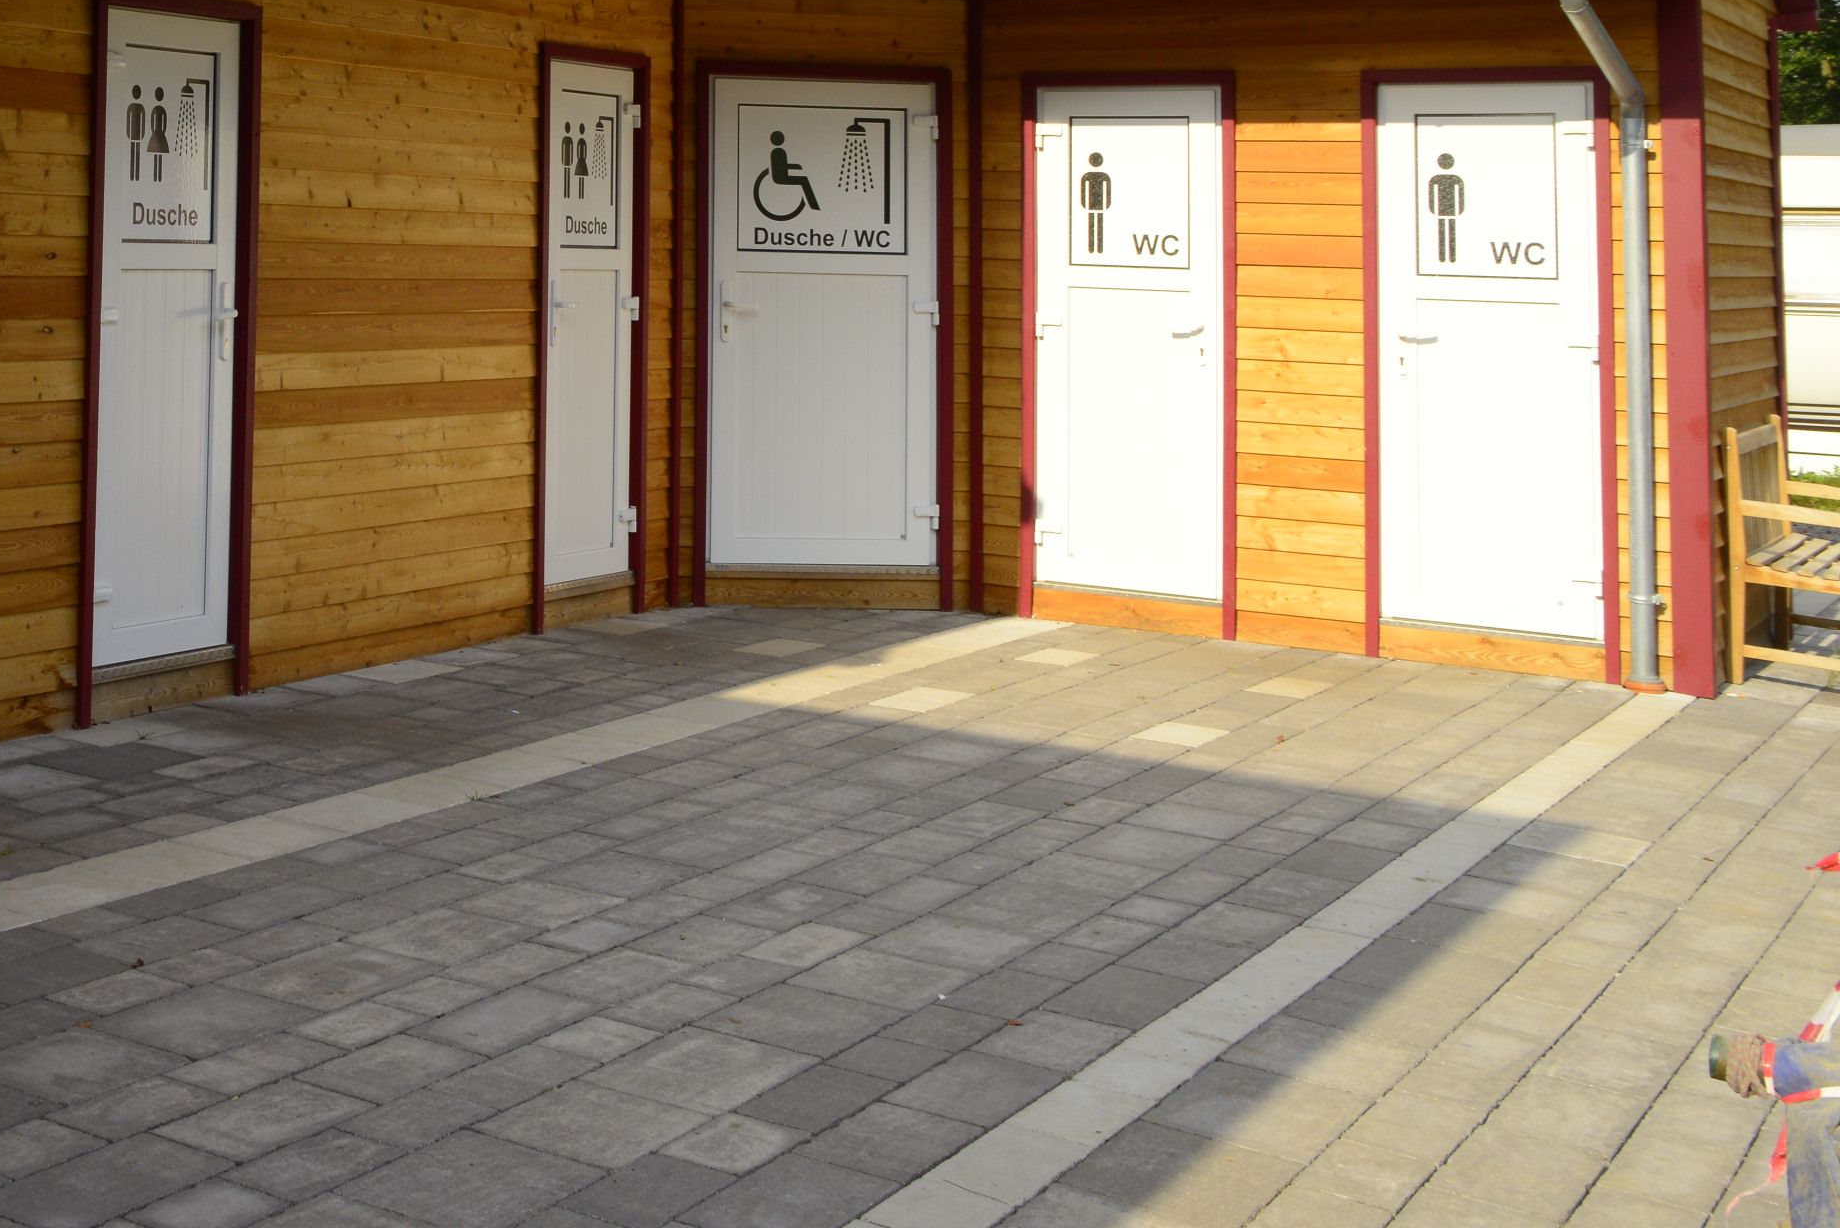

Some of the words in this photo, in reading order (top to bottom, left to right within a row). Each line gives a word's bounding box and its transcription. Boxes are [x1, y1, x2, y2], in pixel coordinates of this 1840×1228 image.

[132, 202, 198, 227] Dusche
[565, 215, 608, 235] Dusche
[754, 227, 835, 247] Dusche
[841, 229, 848, 248] /
[854, 229, 891, 248] WC
[1132, 233, 1180, 256] WC
[1490, 241, 1546, 266] WC
